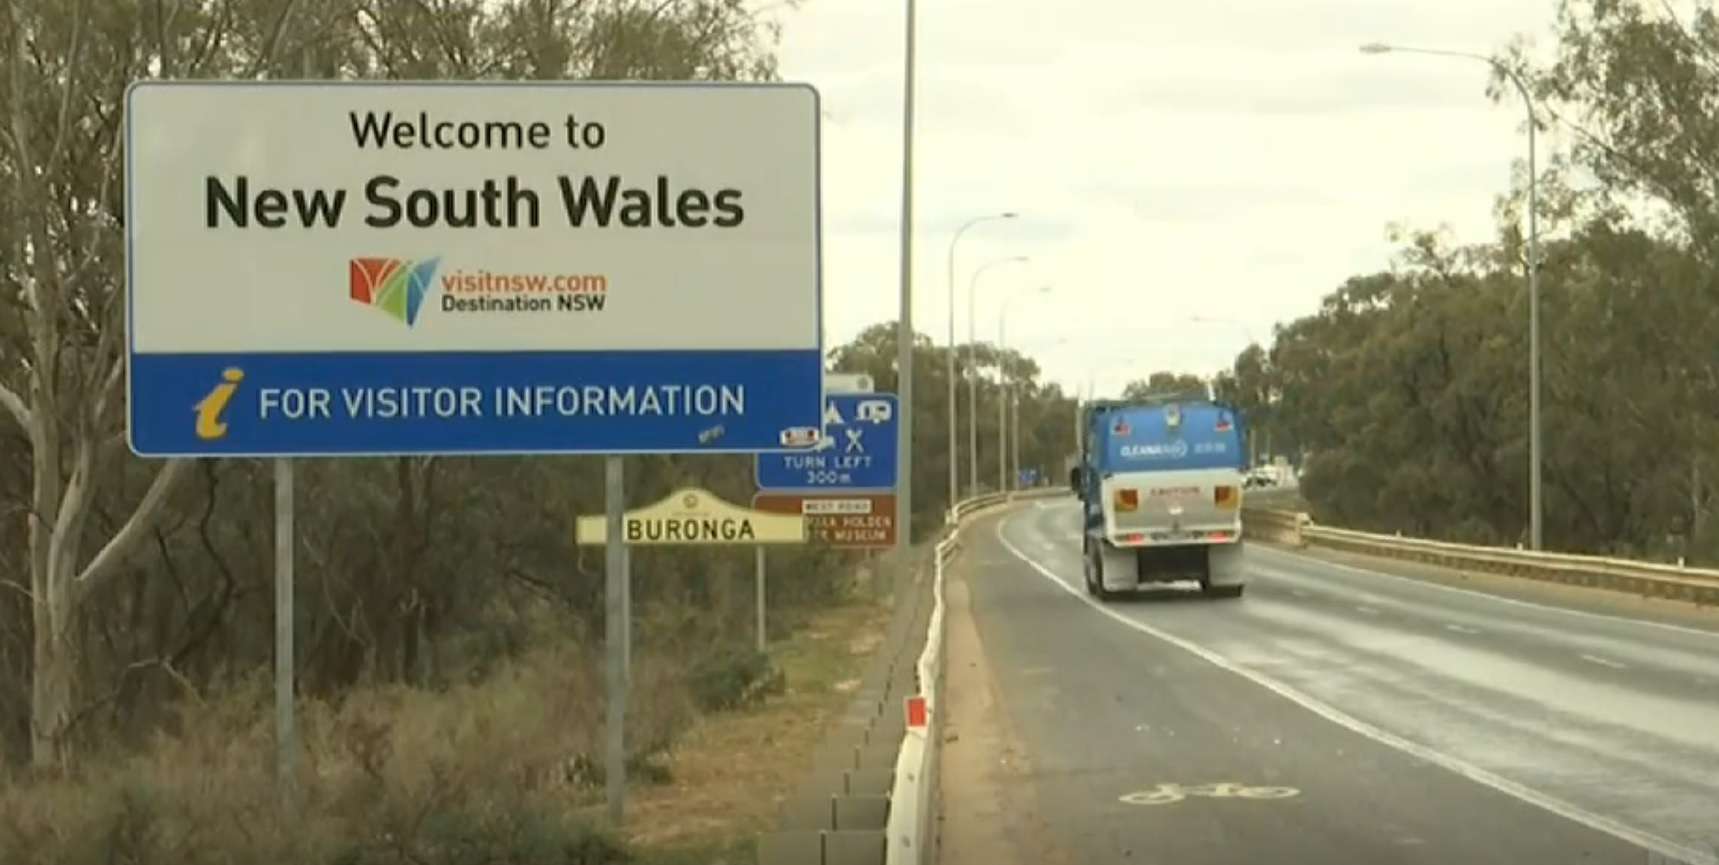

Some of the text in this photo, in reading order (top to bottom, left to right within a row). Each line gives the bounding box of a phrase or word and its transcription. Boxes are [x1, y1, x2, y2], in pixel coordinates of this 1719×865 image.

[350, 111, 605, 150] Welcome to
[206, 174, 745, 229] New South Wales
[441, 270, 607, 294] visitnsw.com
[441, 295, 605, 313] Destination NSW
[259, 385, 745, 419] FOR VISITOR INFORMATION
[784, 456, 872, 468] TURN LEFT
[626, 518, 755, 541] BURONGA
